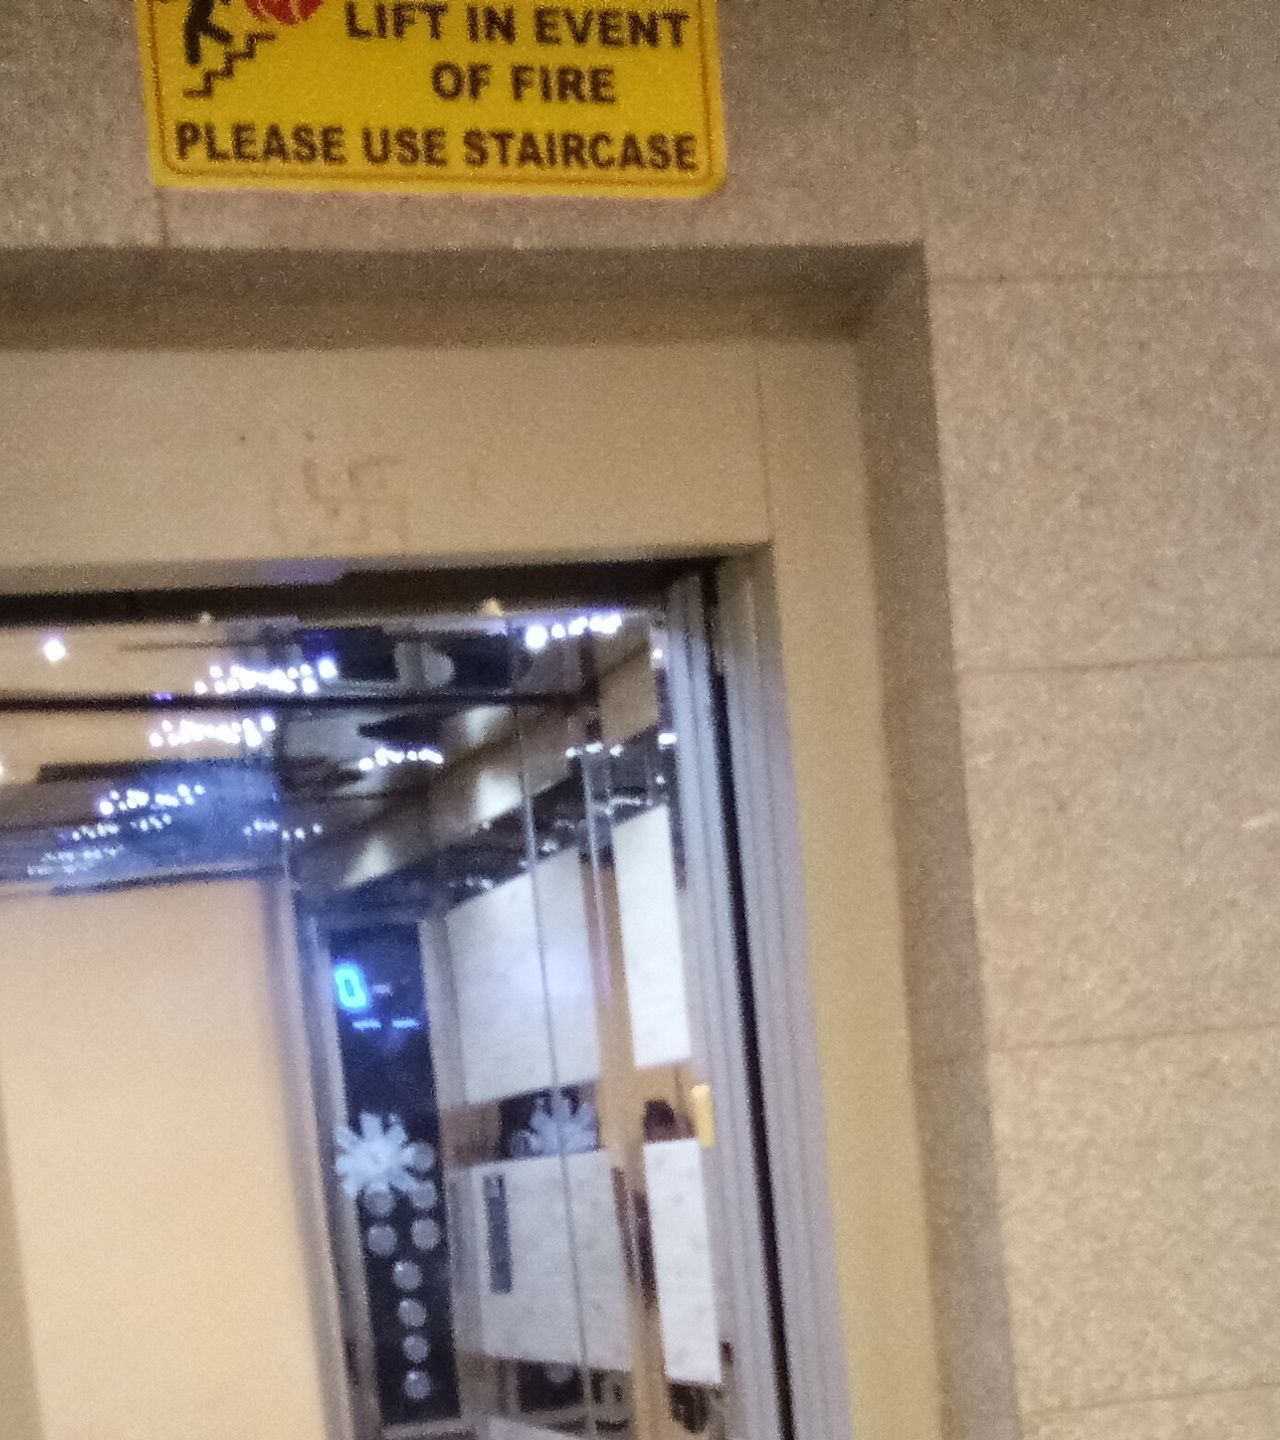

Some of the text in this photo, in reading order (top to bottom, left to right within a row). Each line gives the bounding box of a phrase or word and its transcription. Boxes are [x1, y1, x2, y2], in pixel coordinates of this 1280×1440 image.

[343, 0, 689, 48] LIFT IN EVENT
[431, 61, 616, 104] OF FIRE
[173, 121, 699, 171] PLEASE USE STAIRCASE
